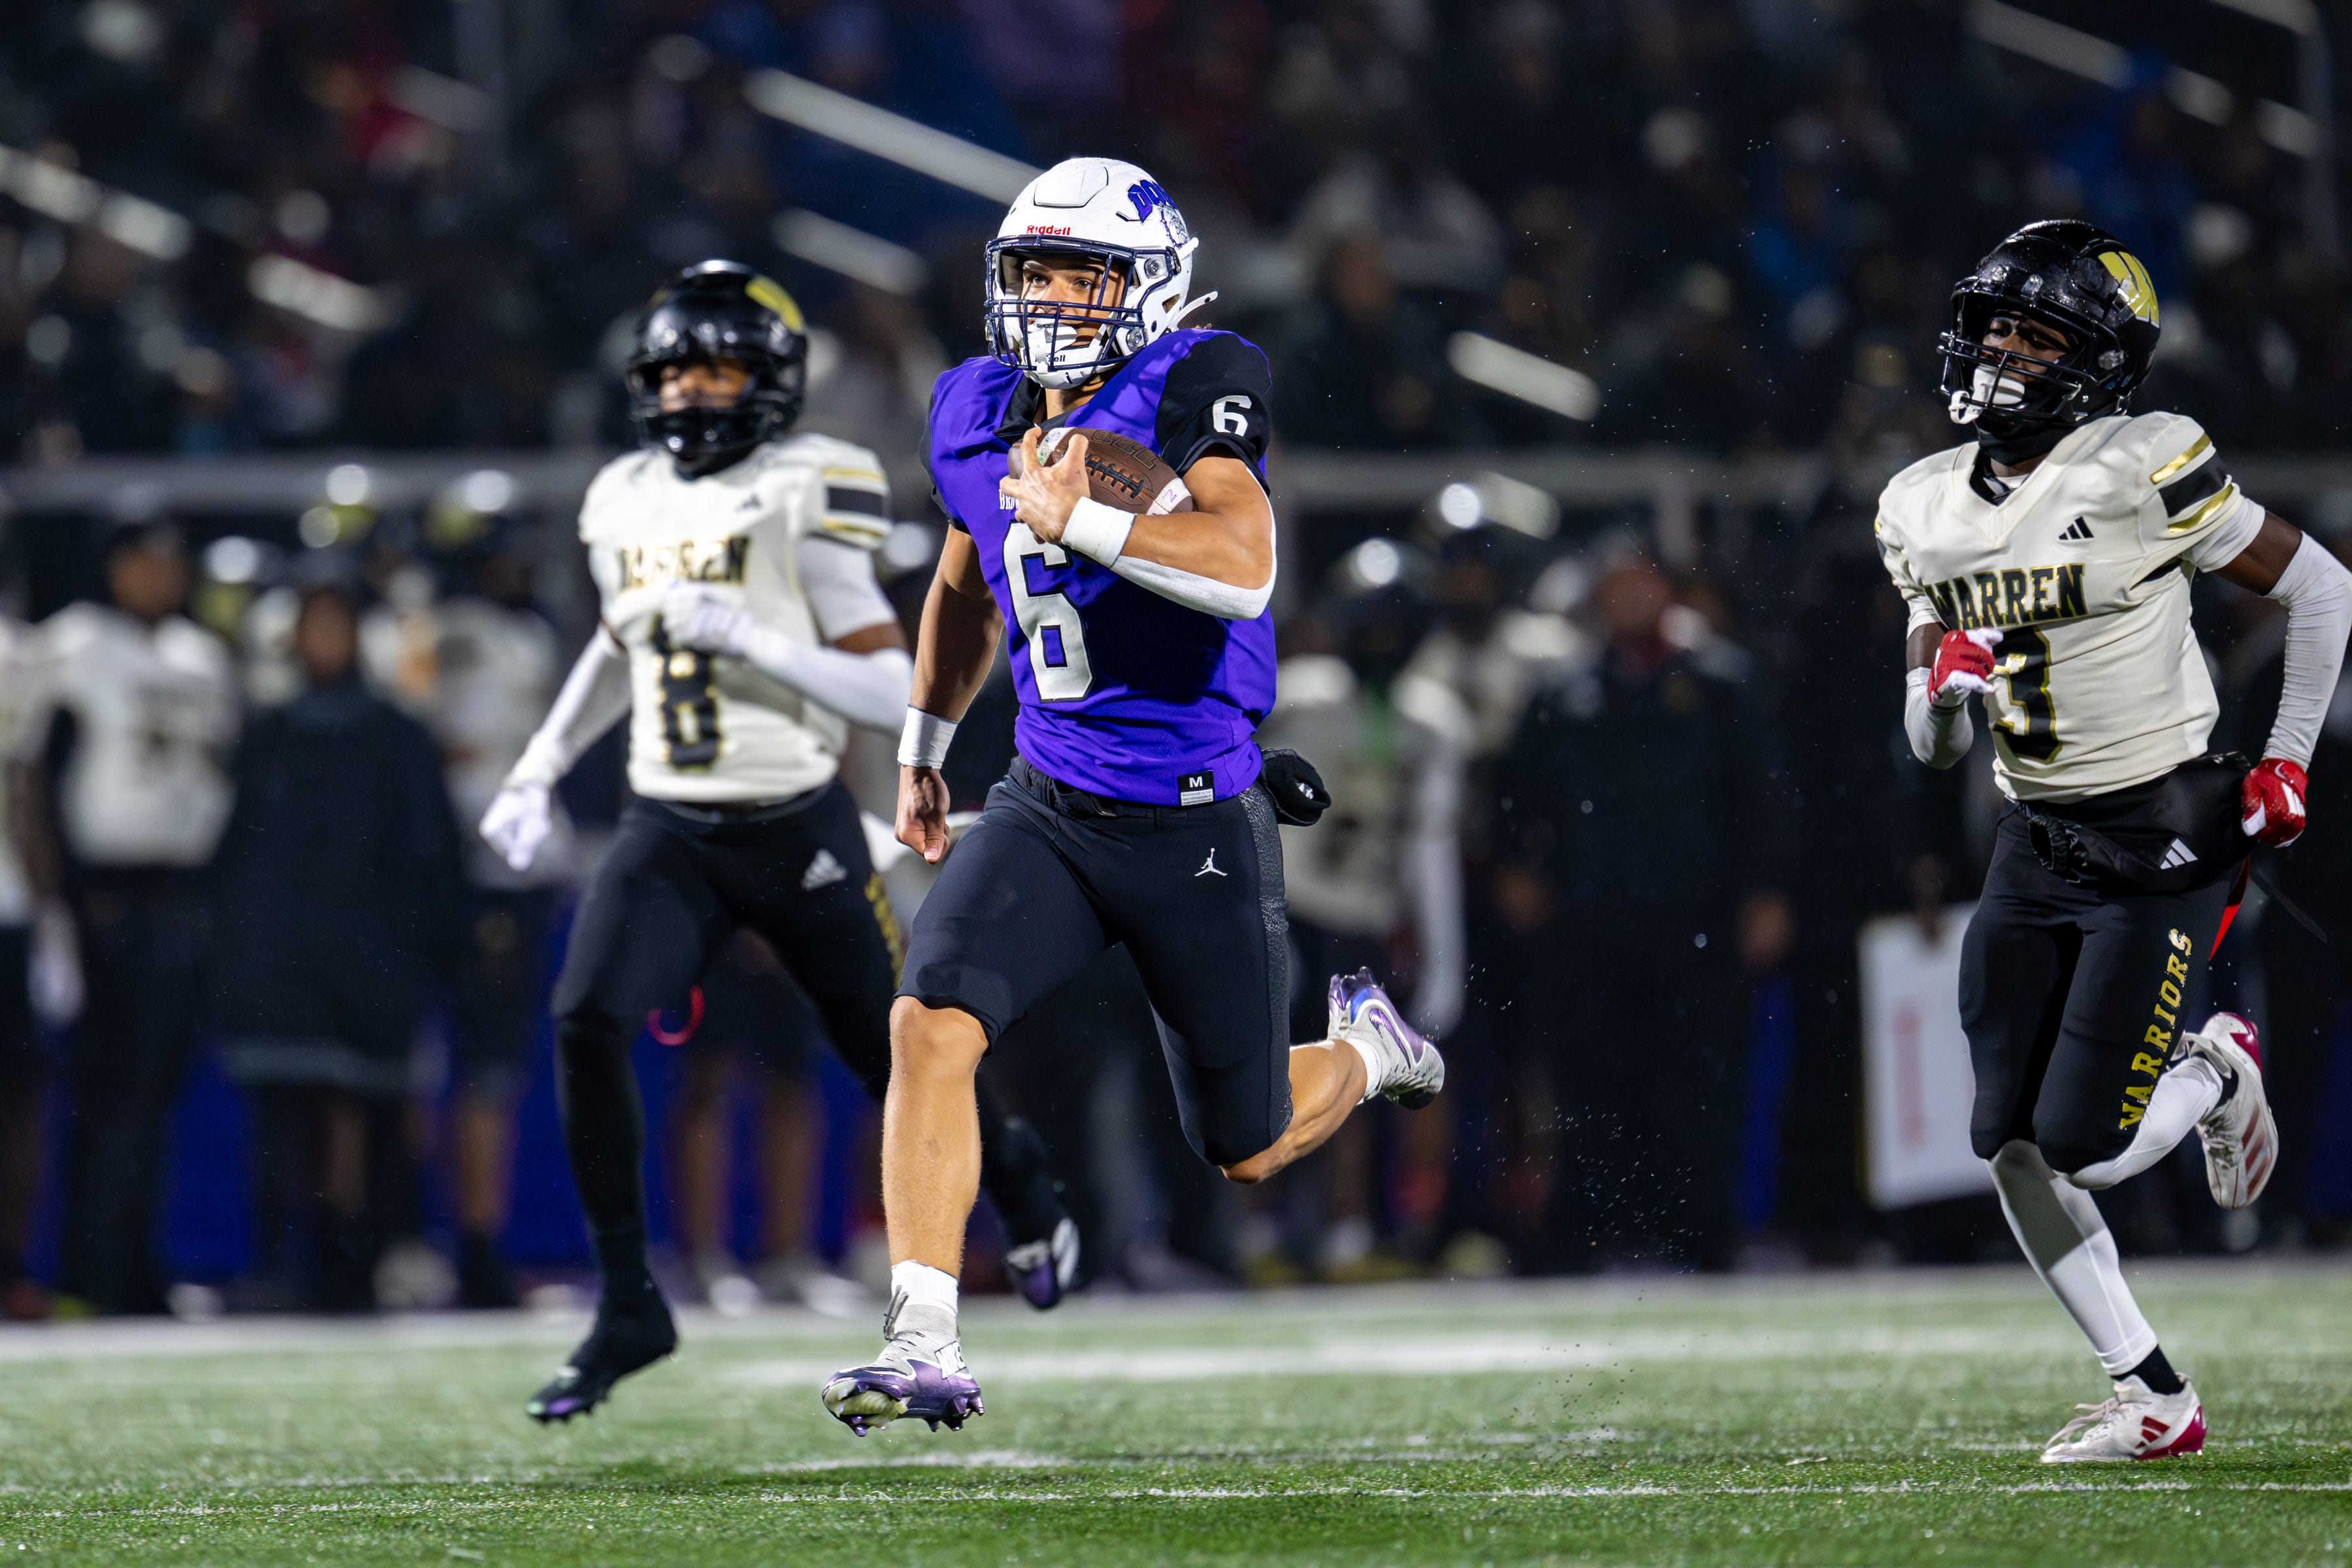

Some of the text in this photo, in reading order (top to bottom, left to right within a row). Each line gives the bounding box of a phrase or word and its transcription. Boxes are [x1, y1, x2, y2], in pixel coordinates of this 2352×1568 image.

[1026, 225, 1070, 236] Riddell
[1213, 395, 1252, 437] 6
[1002, 519, 1096, 704] 6
[1923, 563, 2087, 631] WARREN
[1992, 625, 2063, 764] 3
[1189, 776, 1203, 788] M
[2119, 928, 2192, 1130] WARRIORS
